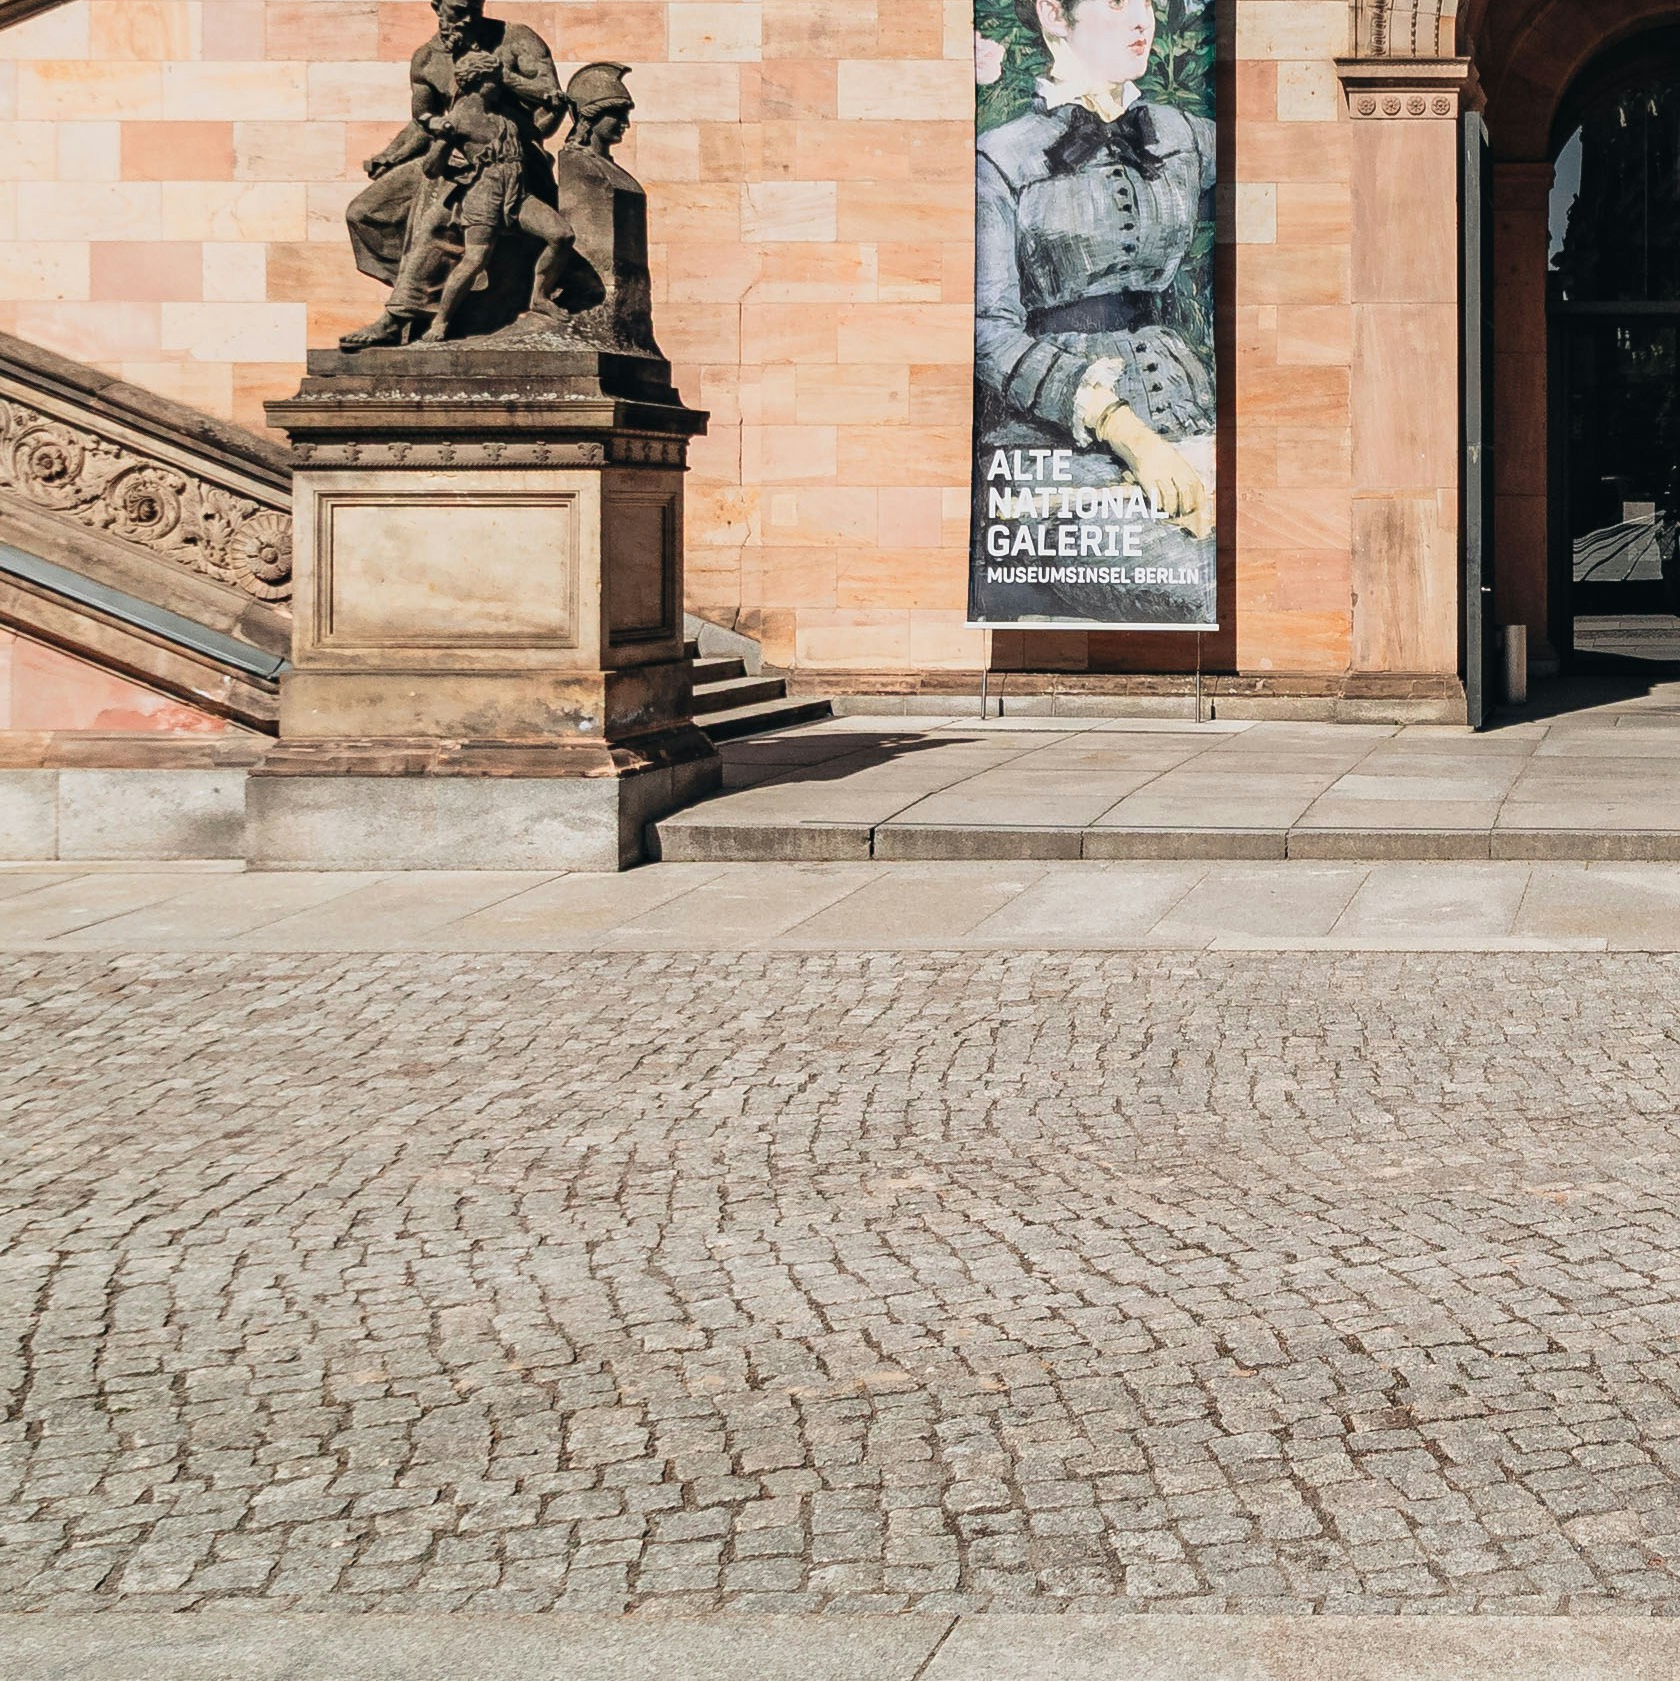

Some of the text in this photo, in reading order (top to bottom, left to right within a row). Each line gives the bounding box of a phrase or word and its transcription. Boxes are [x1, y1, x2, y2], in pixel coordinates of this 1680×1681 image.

[986, 449, 1073, 481] ALTE
[988, 486, 1169, 519] NATIONAL
[987, 524, 1143, 557] GALERIE
[987, 566, 1199, 585] MUSEUMSINSEL BERLIN
